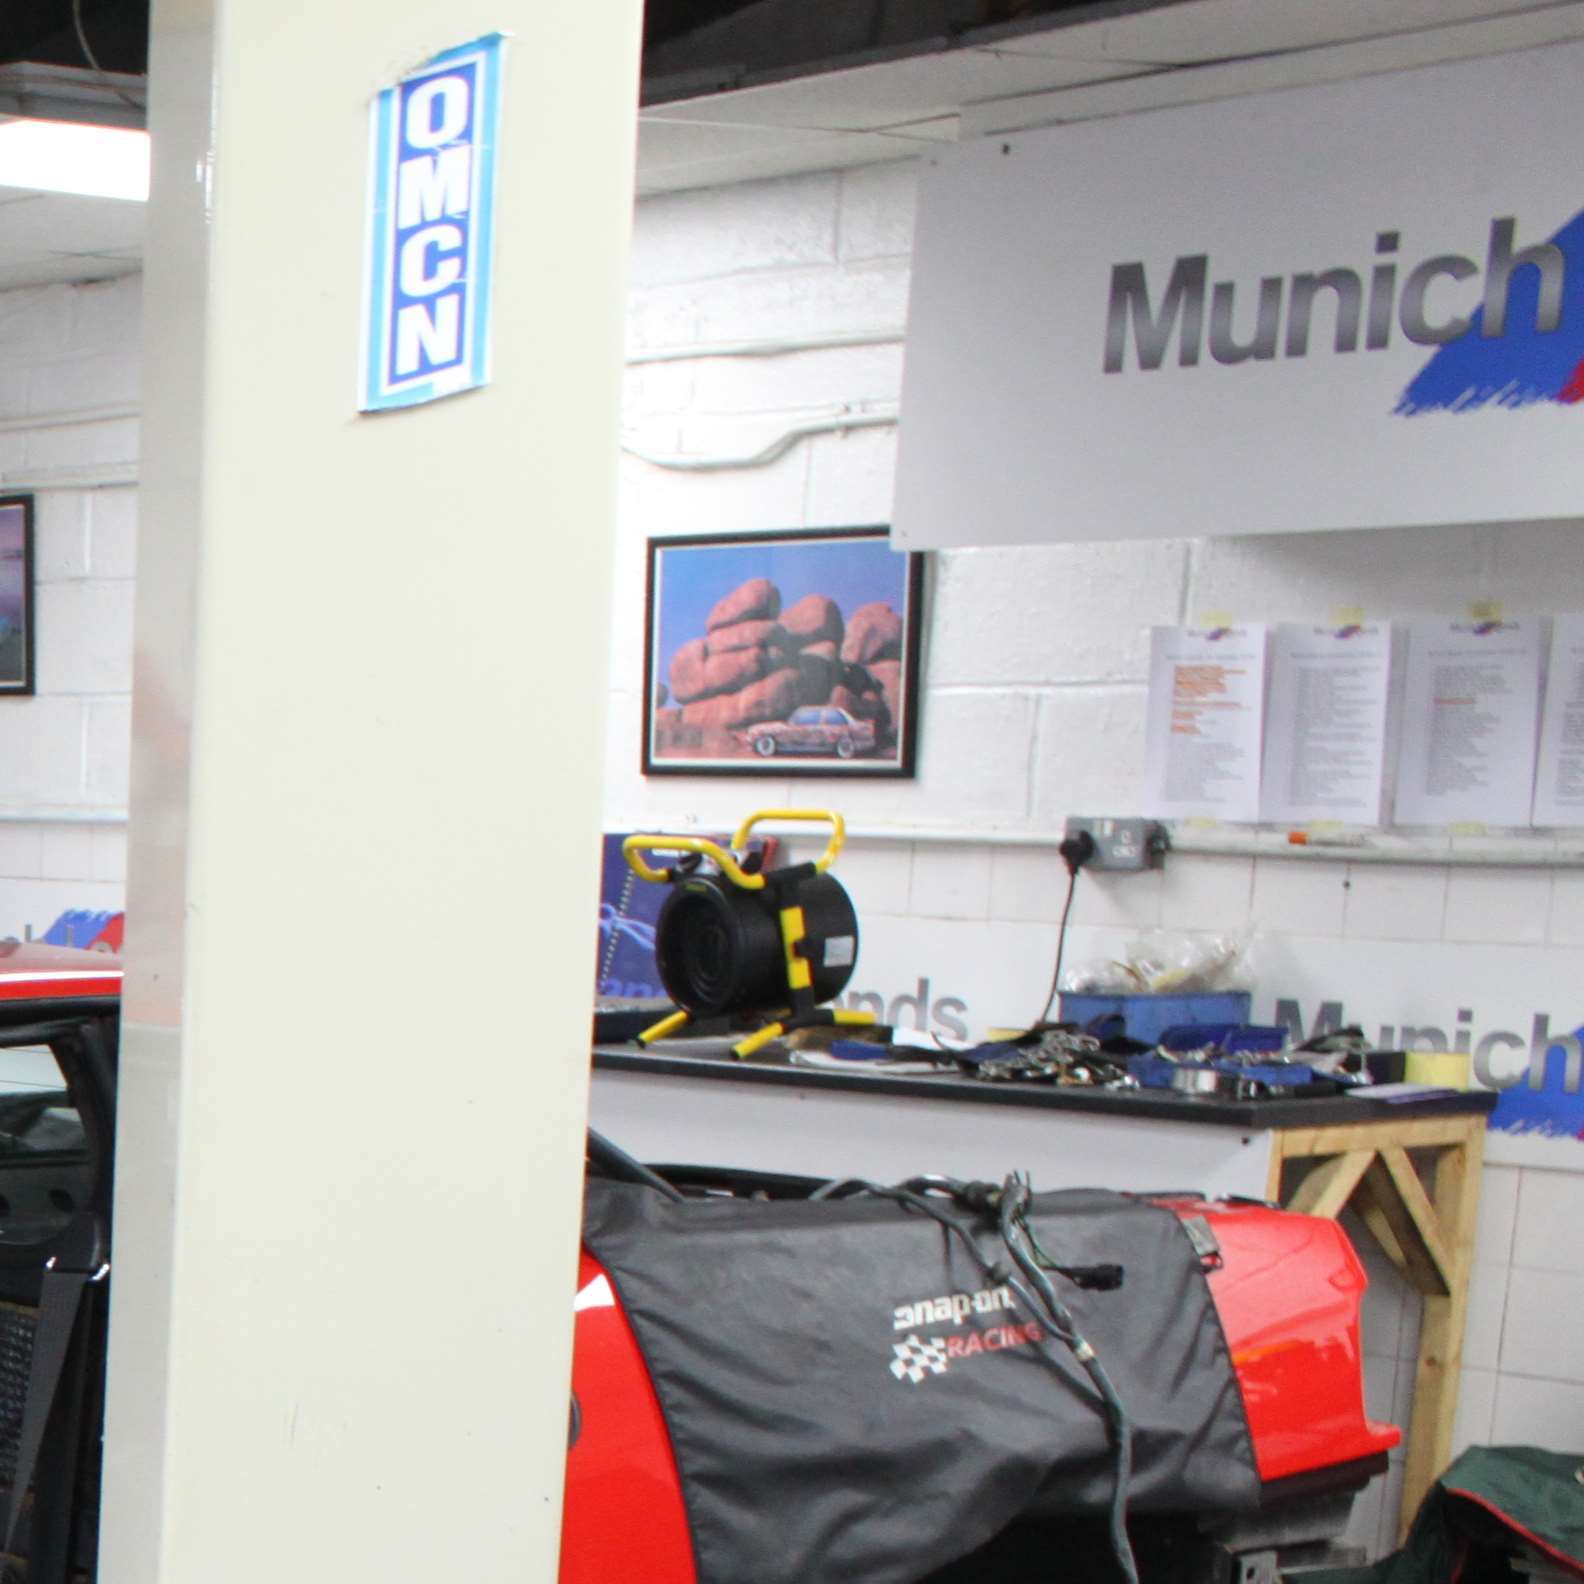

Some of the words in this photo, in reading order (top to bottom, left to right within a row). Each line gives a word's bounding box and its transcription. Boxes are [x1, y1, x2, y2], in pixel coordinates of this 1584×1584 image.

[395, 76, 471, 376] OMCN
[1103, 216, 1565, 374] Munich
[946, 1320, 1042, 1358] RACING
